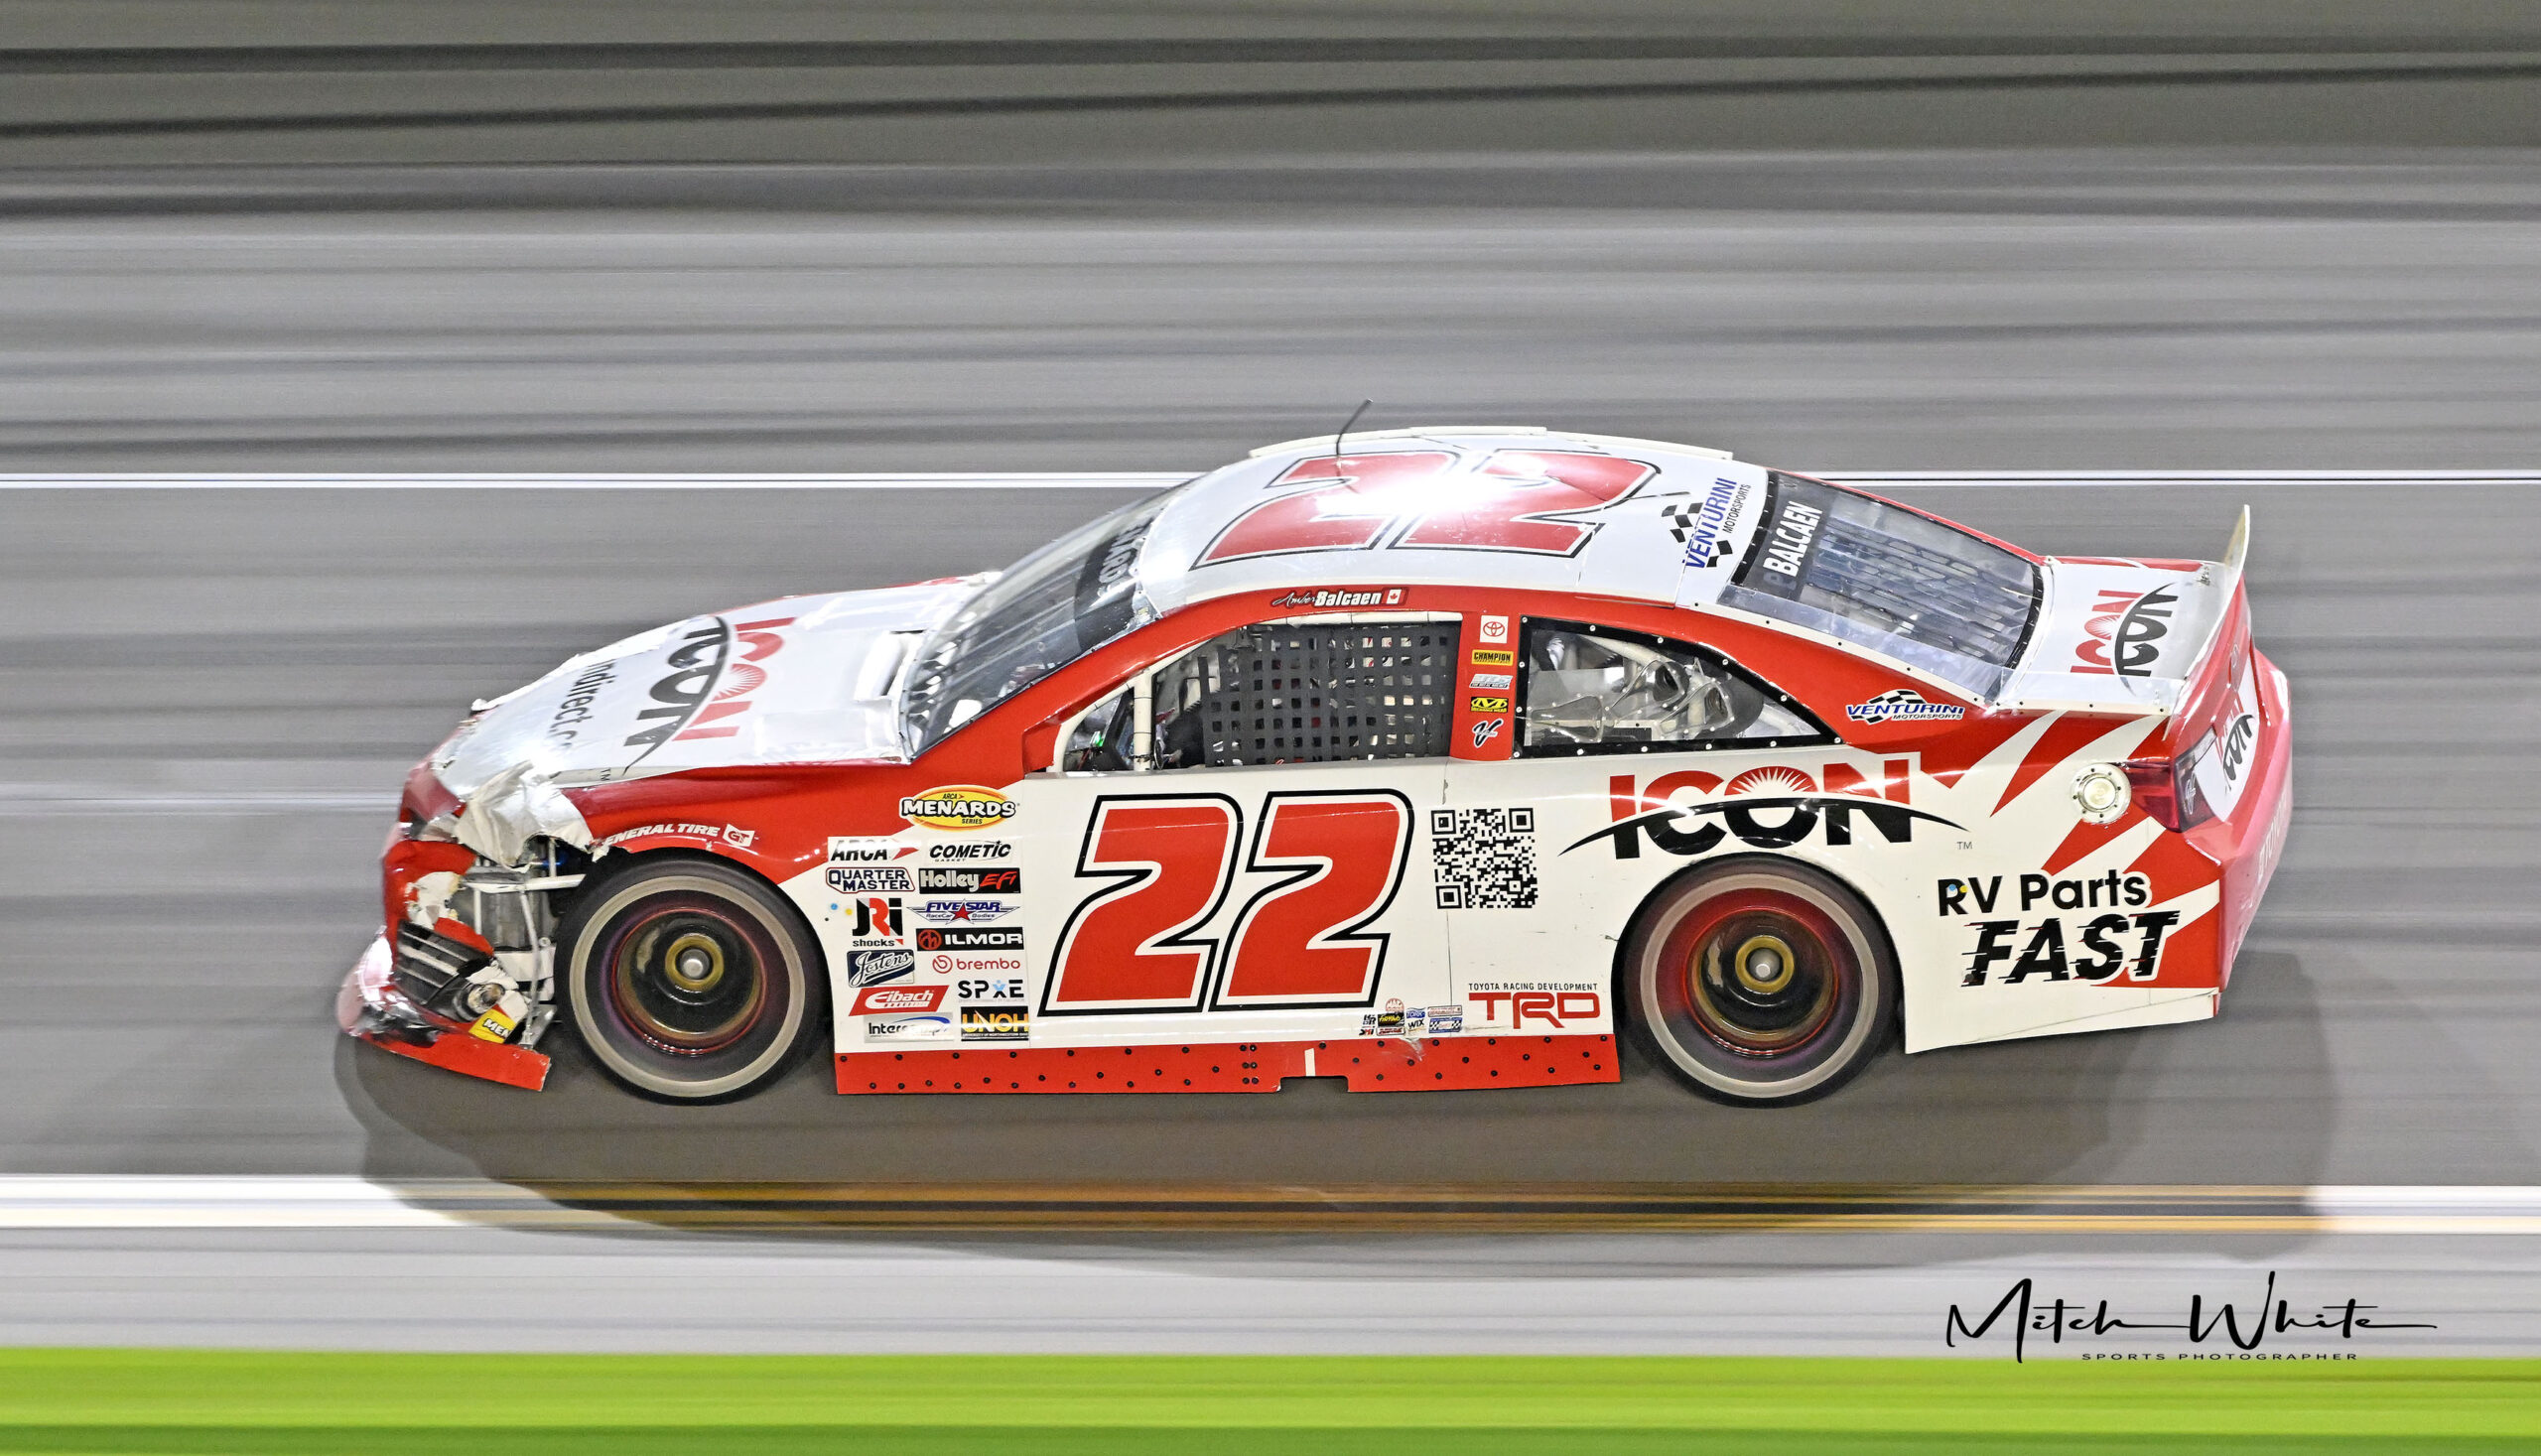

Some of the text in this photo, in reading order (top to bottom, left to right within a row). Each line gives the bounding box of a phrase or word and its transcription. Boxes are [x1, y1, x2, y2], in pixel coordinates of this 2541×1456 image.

[1191, 449, 1662, 570] 22
[1721, 483, 1751, 534] MOTORSPORTS
[1683, 477, 1737, 569] VENTURINI
[1763, 501, 1823, 578] BALCAEN
[1314, 591, 1383, 606] Balcaen
[2071, 583, 2179, 678] ICON
[1473, 651, 1511, 661] CHAMPION
[1847, 704, 1965, 715] VENTURINI
[901, 798, 1016, 819] MENARDS
[1609, 758, 1912, 860] ICON
[677, 823, 721, 837] TIRE
[831, 839, 888, 861] ARCA
[929, 843, 1012, 860] COMETIC
[1957, 841, 1973, 850] TM
[828, 869, 906, 885] QUARTER
[844, 879, 911, 892] MASTER
[919, 869, 980, 892] Holley
[1037, 788, 1415, 1017] 22
[1938, 869, 2147, 917] RV Parts
[925, 901, 1001, 912] FIVE STAR
[853, 938, 895, 948] shocks
[945, 933, 1023, 945] ILMOR
[1960, 910, 2182, 988] FAST
[850, 950, 914, 988] Jostens
[956, 958, 1021, 970] brembo
[1538, 983, 1598, 992] DEVELOPMENT
[865, 989, 934, 1009] Eibach
[1469, 992, 1601, 1029] TRD
[961, 1012, 1028, 1033] UNOH
